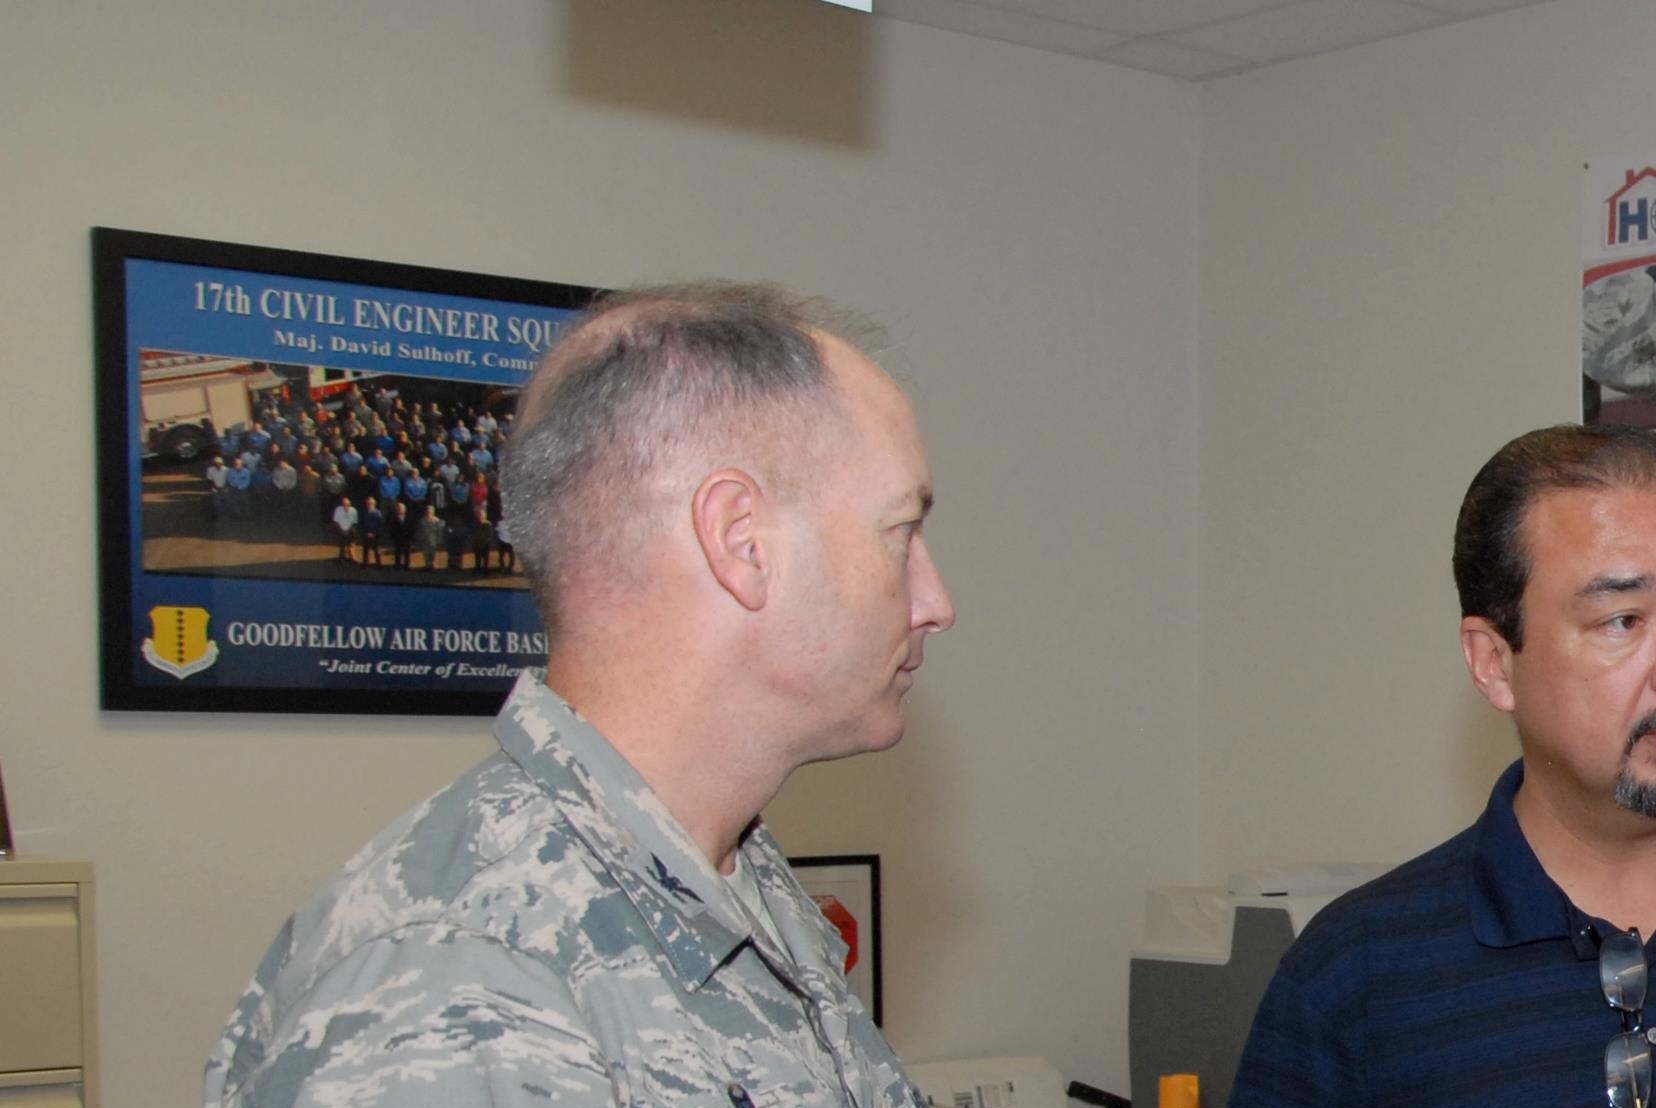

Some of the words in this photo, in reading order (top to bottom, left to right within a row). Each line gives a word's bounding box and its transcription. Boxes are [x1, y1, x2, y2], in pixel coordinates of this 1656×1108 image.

[194, 281, 251, 316] 17th
[260, 289, 346, 327] CIVIL
[354, 299, 499, 343] ENGINEER
[274, 330, 323, 351] Maj.
[331, 335, 391, 357] David
[398, 341, 477, 368] Sulhoff,
[228, 621, 386, 651] GOODFELLOW
[390, 627, 427, 651] AIR
[432, 629, 501, 653] FORCE
[376, 660, 430, 676] Center
[434, 662, 455, 679] of
